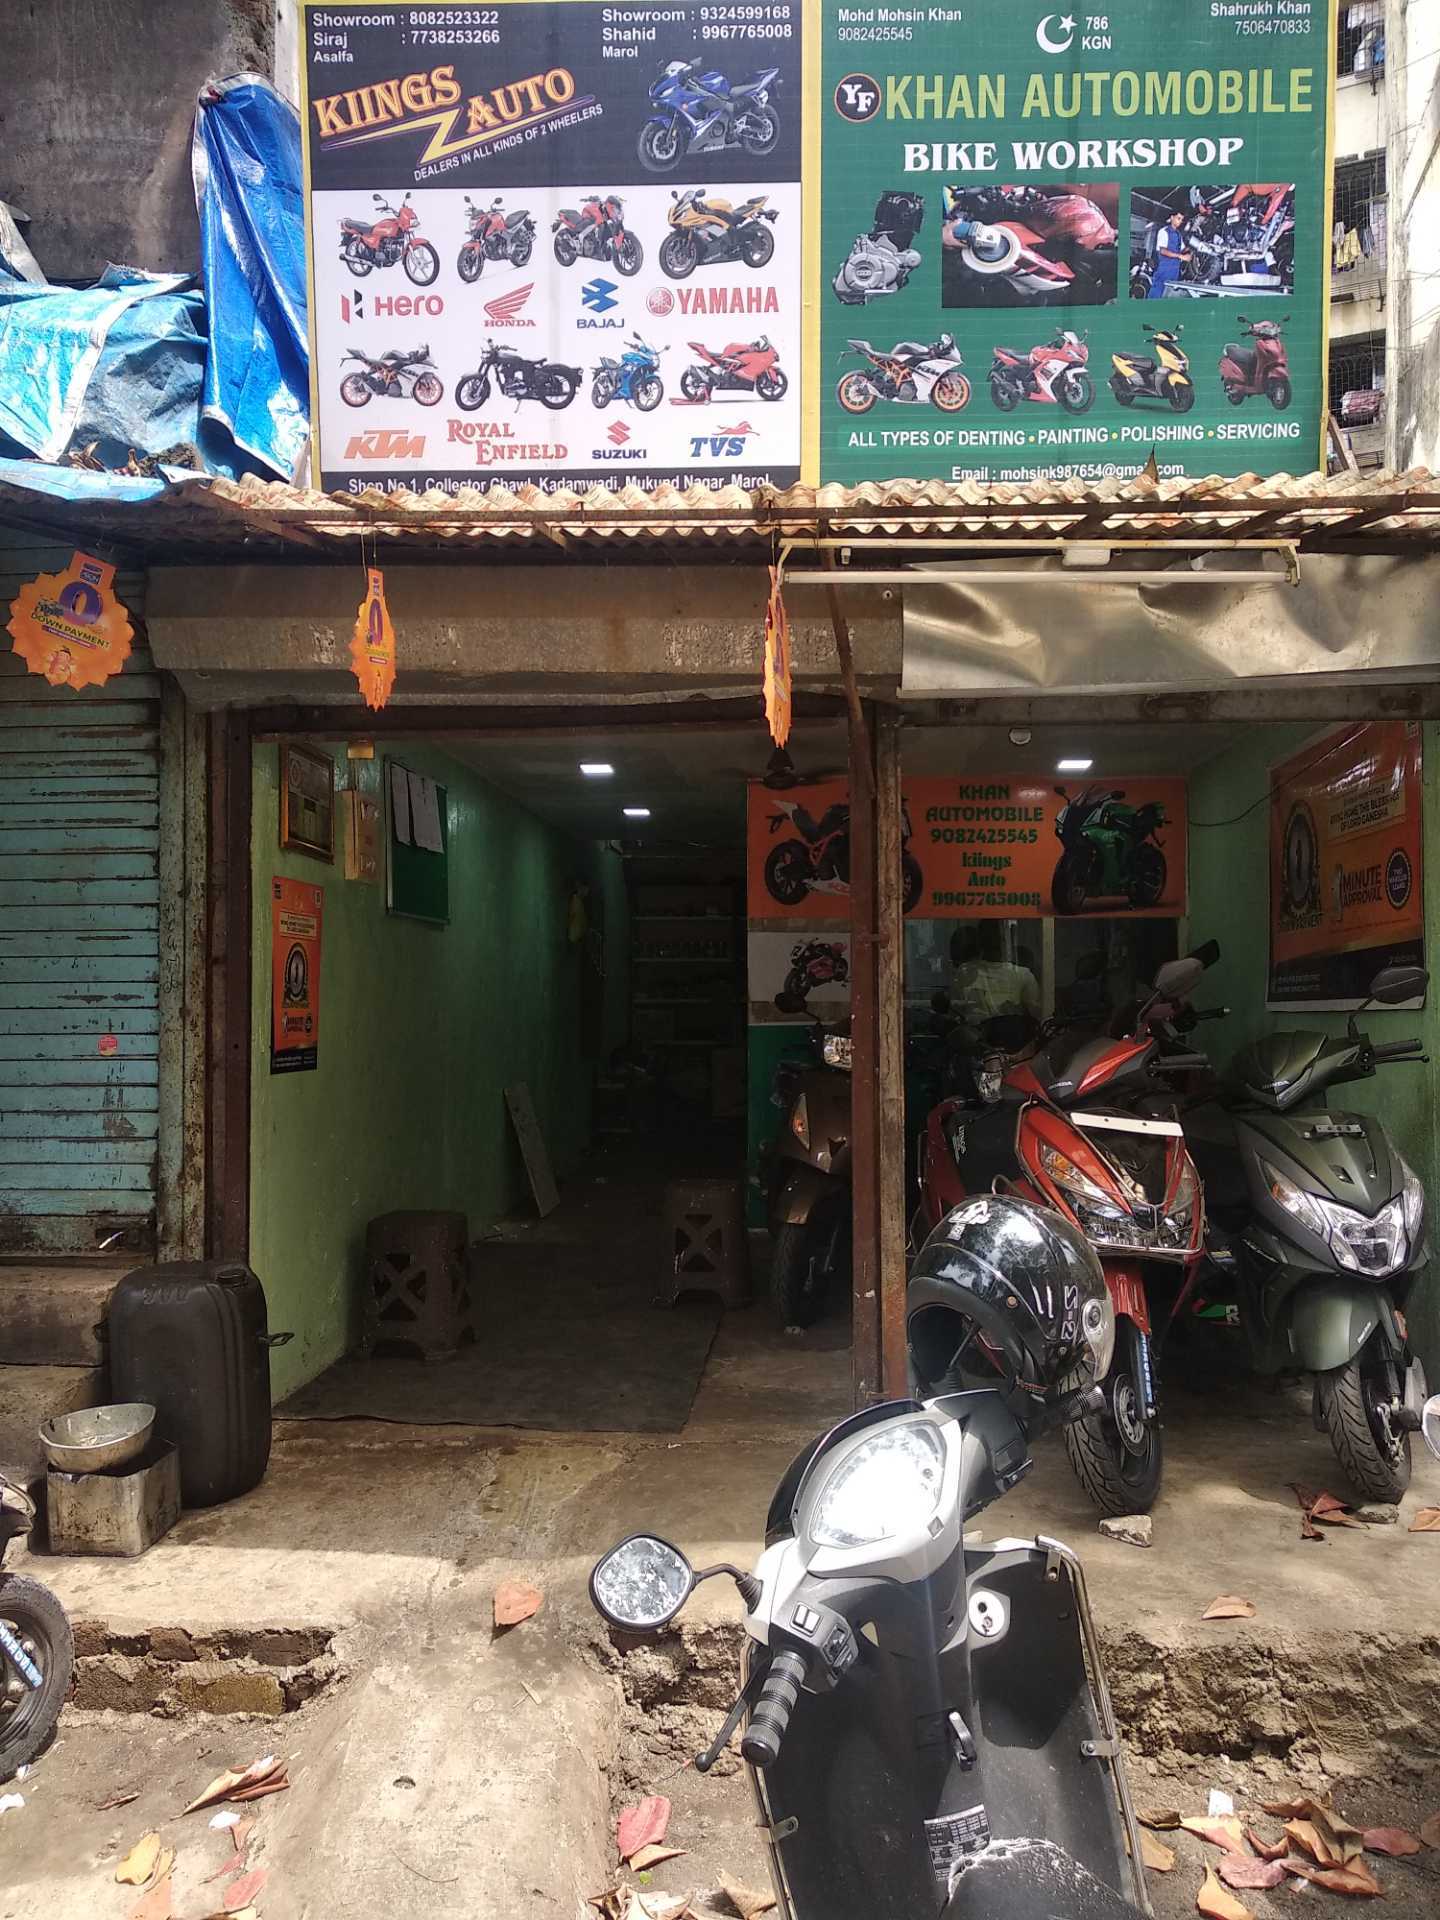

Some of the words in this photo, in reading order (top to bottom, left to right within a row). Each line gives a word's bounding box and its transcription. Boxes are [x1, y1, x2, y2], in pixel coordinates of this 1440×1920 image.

[602, 9, 686, 22] Showroom
[699, 6, 791, 20] 9324599168
[838, 8, 874, 22] Mohd
[877, 8, 926, 22] Mohsin
[928, 8, 962, 21] Khan
[1210, 2, 1273, 17] Shahrukh
[1276, 1, 1311, 15] Khan
[312, 13, 395, 27] Showroom
[409, 11, 499, 26] 8082523322
[1085, 16, 1109, 30] 786
[1234, 19, 1311, 35] 7506470833
[313, 32, 349, 51] Siraj
[411, 30, 501, 45] 7738253266
[602, 27, 656, 41] Shahid
[701, 24, 792, 39] 9967765008
[838, 27, 913, 41] 9082425545
[1081, 35, 1112, 50] KGN
[313, 50, 354, 63] Asalfa
[602, 46, 638, 58] Marol
[465, 66, 577, 135] AUTO
[886, 74, 1006, 120] KHAN
[1022, 68, 1313, 118] AUTOMOBILE
[414, 156, 460, 181] DEALERS
[461, 153, 471, 165] IN
[473, 145, 494, 161] ALL
[493, 133, 523, 152] KINDS
[524, 126, 539, 140] OF
[541, 125, 547, 137] 2
[548, 104, 604, 133] WHEELERS
[904, 142, 1000, 171] BIKE
[1011, 138, 1244, 170] WORKSHOP
[374, 295, 444, 317] Hero
[676, 287, 780, 315] YAMAHA
[483, 319, 537, 328] HONDA
[576, 318, 625, 329] BAJAJ
[848, 431, 877, 447] ALL
[881, 431, 929, 446] TYPES
[933, 430, 954, 446] OF
[958, 430, 1026, 446] DENTING
[1038, 428, 1109, 444] PAINTING
[1121, 425, 1204, 442] POLISHING
[1216, 422, 1301, 440] SERVICING
[343, 429, 426, 460] KTM
[689, 436, 747, 458] TVS
[592, 449, 648, 460] SUZUKI
[952, 466, 988, 480] Email
[1001, 462, 1184, 480] mohsink987654@gmacom
[959, 784, 1010, 801] KHAN
[926, 806, 1044, 822] AUTOMOBILE
[930, 828, 1038, 844] 9082425545
[968, 872, 1006, 887] Auto
[1343, 865, 1382, 891] MINUTE
